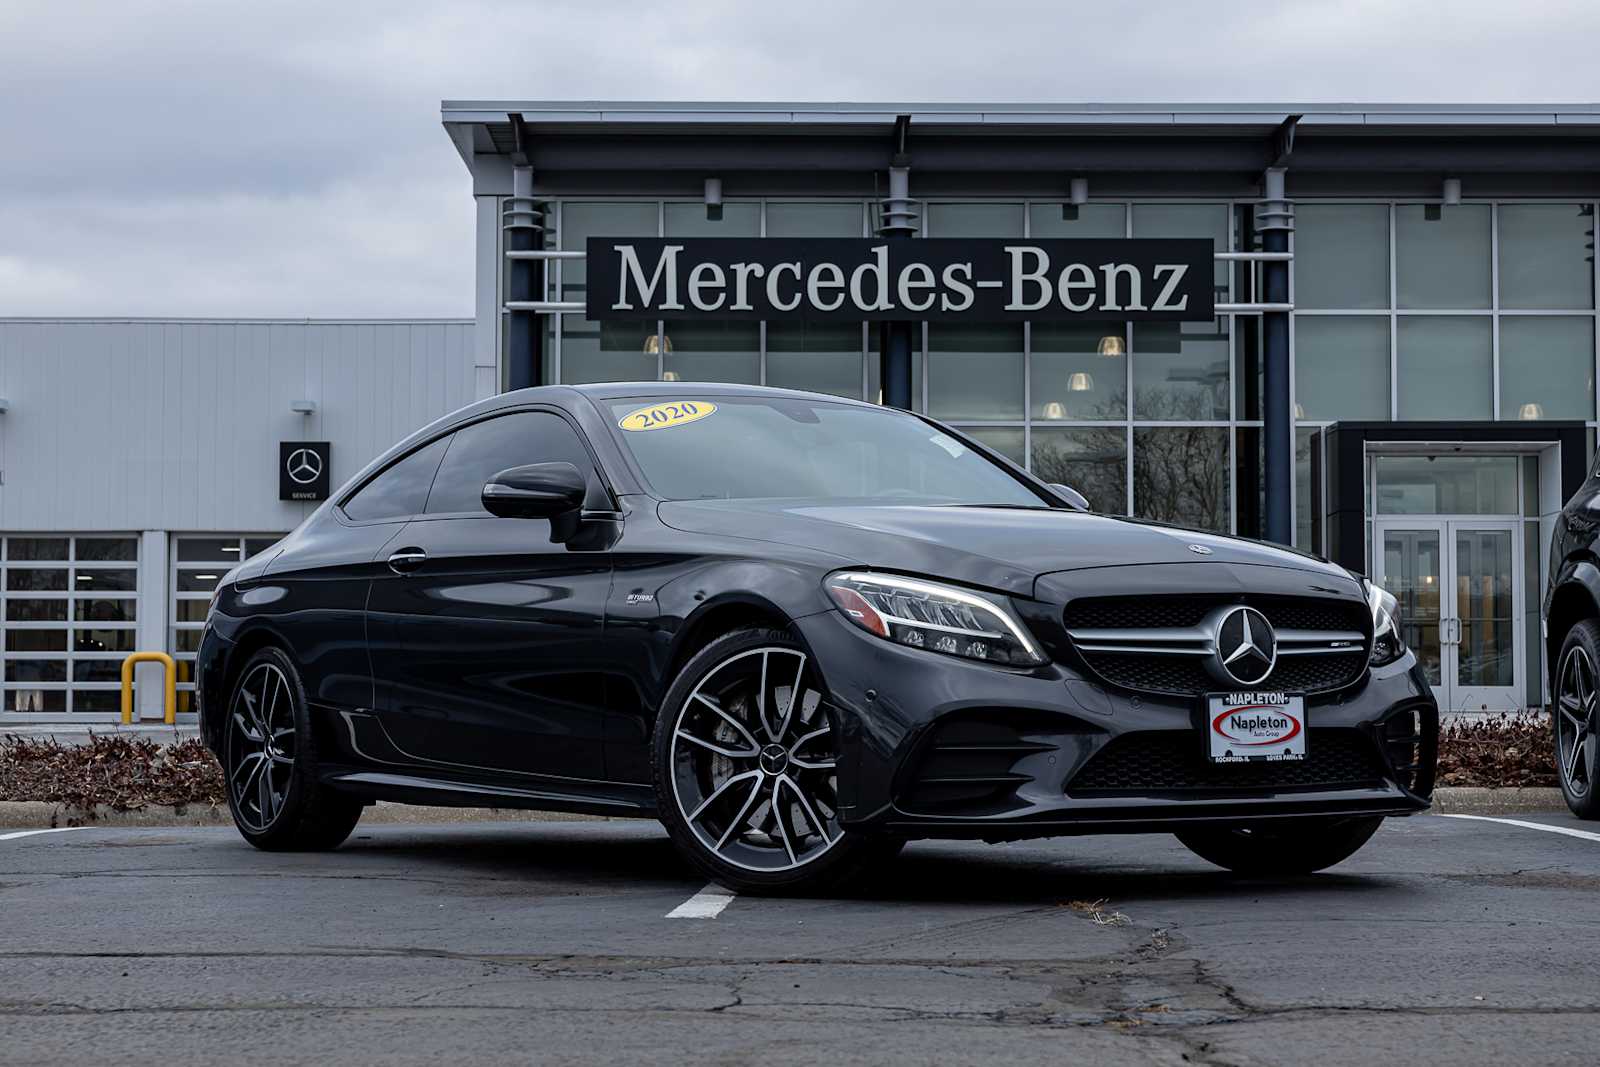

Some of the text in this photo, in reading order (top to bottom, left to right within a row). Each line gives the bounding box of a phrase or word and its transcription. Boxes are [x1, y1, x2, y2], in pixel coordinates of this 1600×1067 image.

[611, 245, 1189, 312] Mercedes-Benz
[635, 403, 697, 427] 2020
[1231, 715, 1288, 732] Napleton
